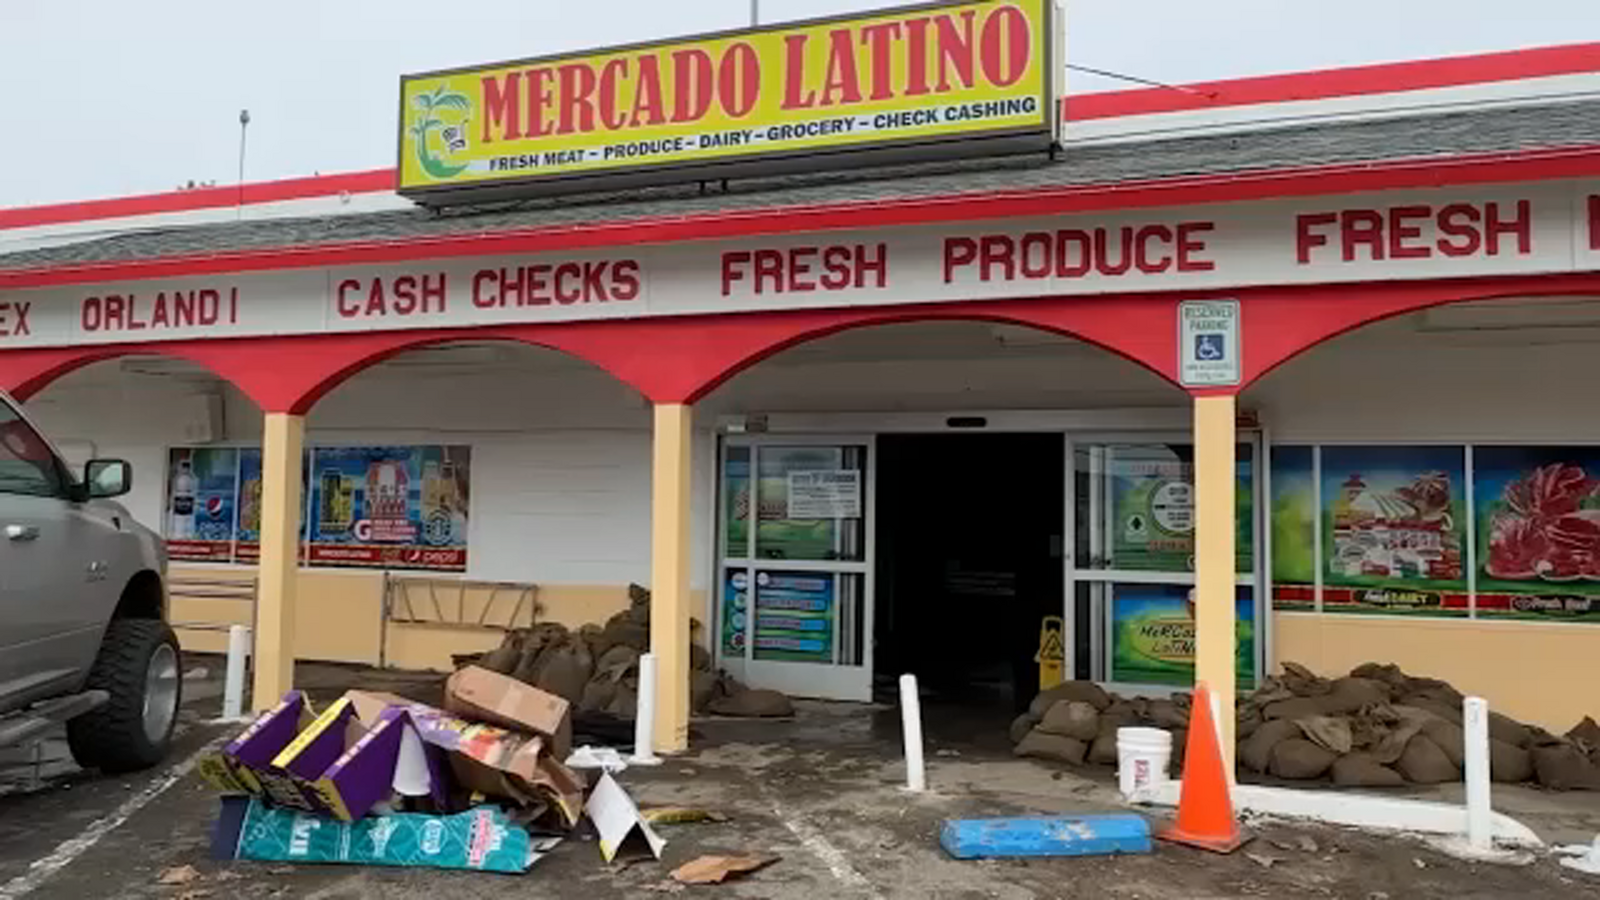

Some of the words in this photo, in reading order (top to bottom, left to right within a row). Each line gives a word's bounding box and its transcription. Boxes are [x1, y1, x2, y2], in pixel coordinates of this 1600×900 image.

[481, 43, 761, 141] MERCADO
[780, 5, 1031, 110] LATINO
[490, 156, 539, 171] FRESH
[544, 150, 585, 166] MEAT
[603, 137, 683, 160] PRODUCE
[700, 129, 753, 149] DAIRY
[767, 117, 855, 141] GROCERY
[874, 107, 939, 129] CHECK
[944, 97, 1037, 121] CASHING
[337, 273, 447, 318] CASH
[472, 259, 641, 309] CHECKS
[721, 243, 887, 297] FRESH
[942, 221, 1216, 284] PRODUCE
[1296, 200, 1532, 264] FRESH
